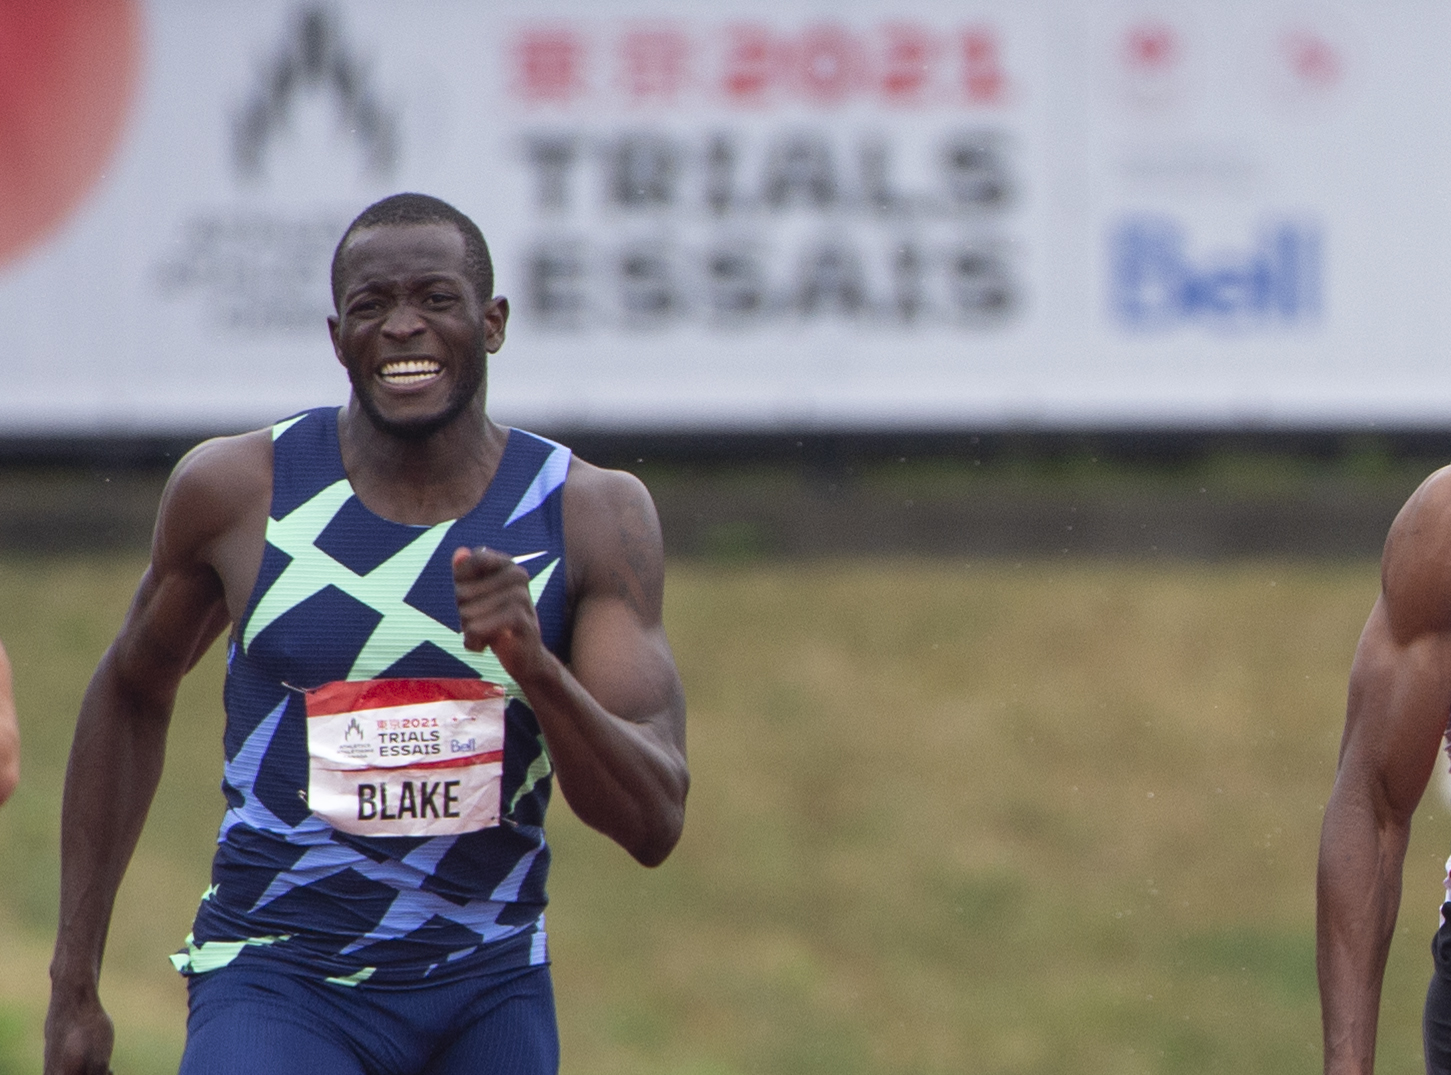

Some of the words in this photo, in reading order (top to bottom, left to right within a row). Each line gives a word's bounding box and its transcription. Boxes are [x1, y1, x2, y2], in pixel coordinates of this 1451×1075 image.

[514, 128, 1014, 214] TRIALS
[518, 238, 1016, 328] ESSAIS
[1106, 212, 1328, 336] Bell
[378, 730, 440, 744] TRIALS
[380, 743, 441, 757] ESSAIS
[450, 738, 476, 753] Bell
[357, 780, 461, 821] BLAKE
